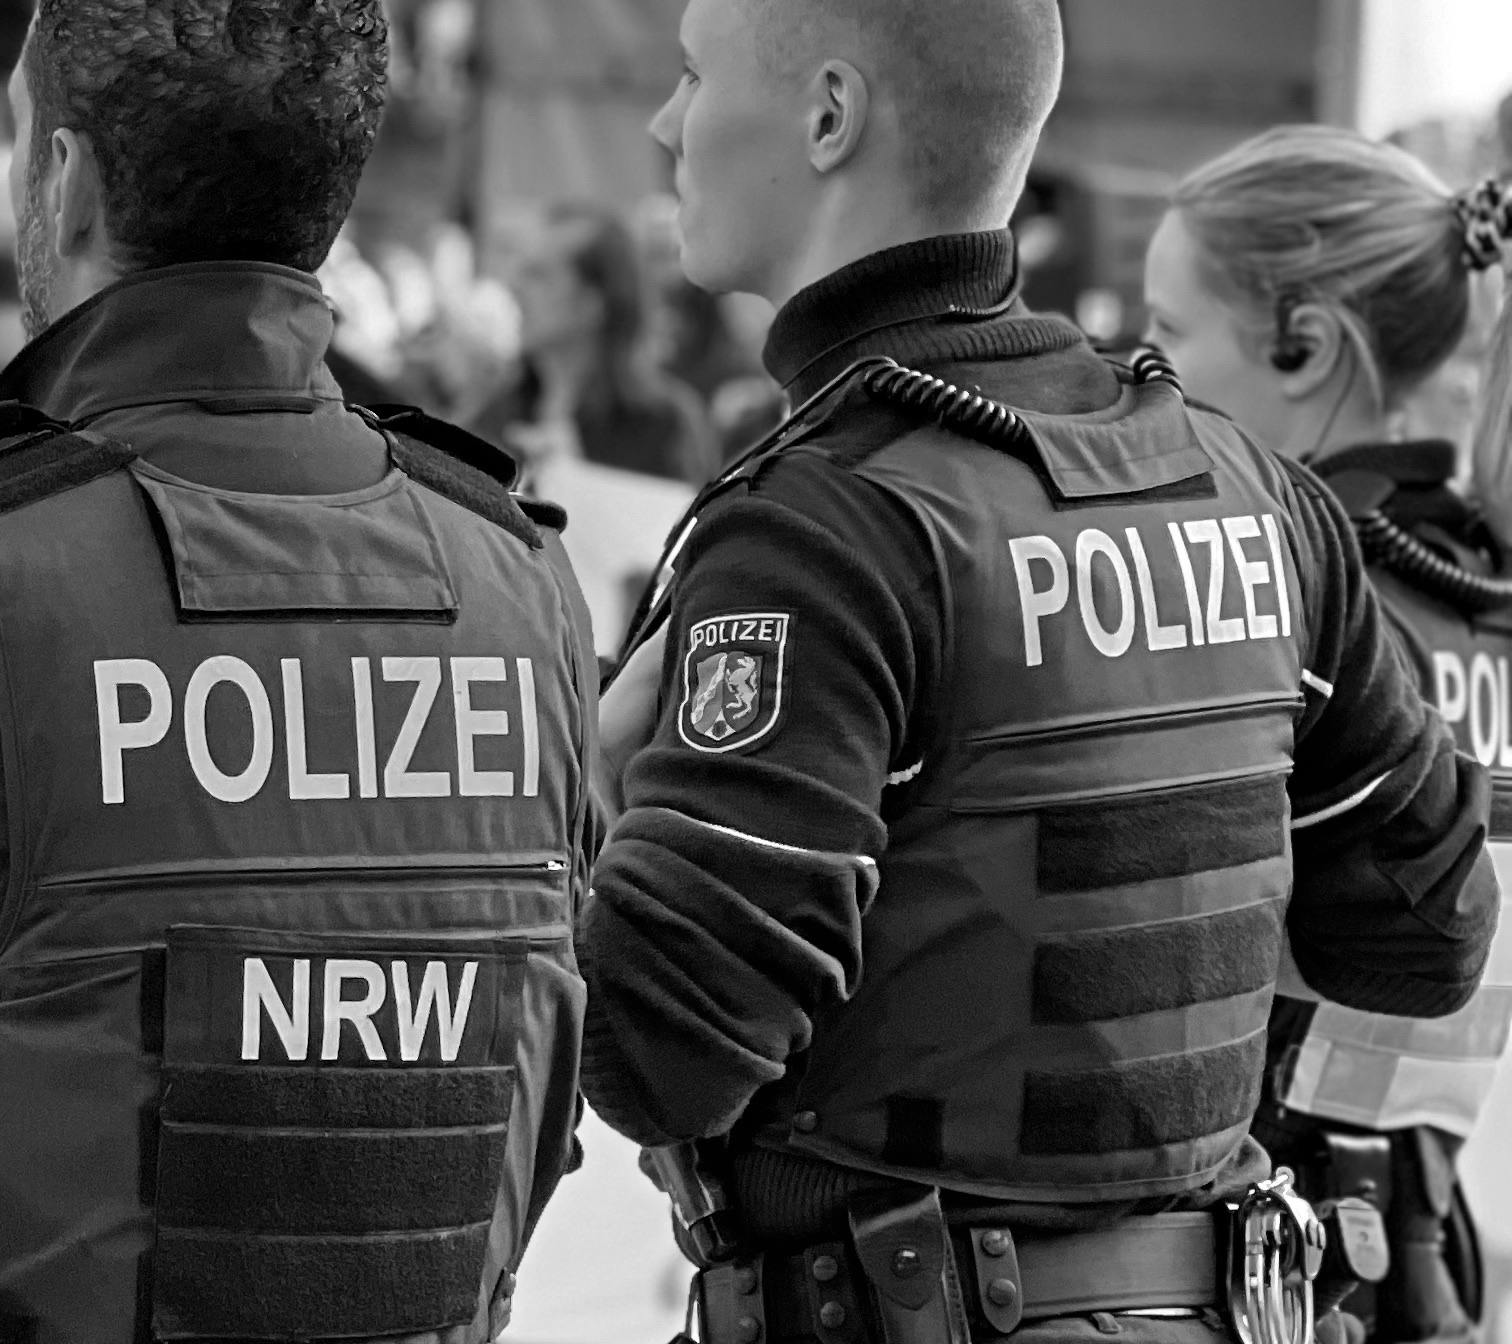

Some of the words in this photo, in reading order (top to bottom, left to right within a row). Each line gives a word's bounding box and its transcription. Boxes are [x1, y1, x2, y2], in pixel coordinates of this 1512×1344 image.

[694, 620, 781, 646] POLIZEI
[1008, 514, 1290, 667] POLIZEI
[94, 656, 539, 804] POLIZEI
[241, 958, 478, 1061] NRW
